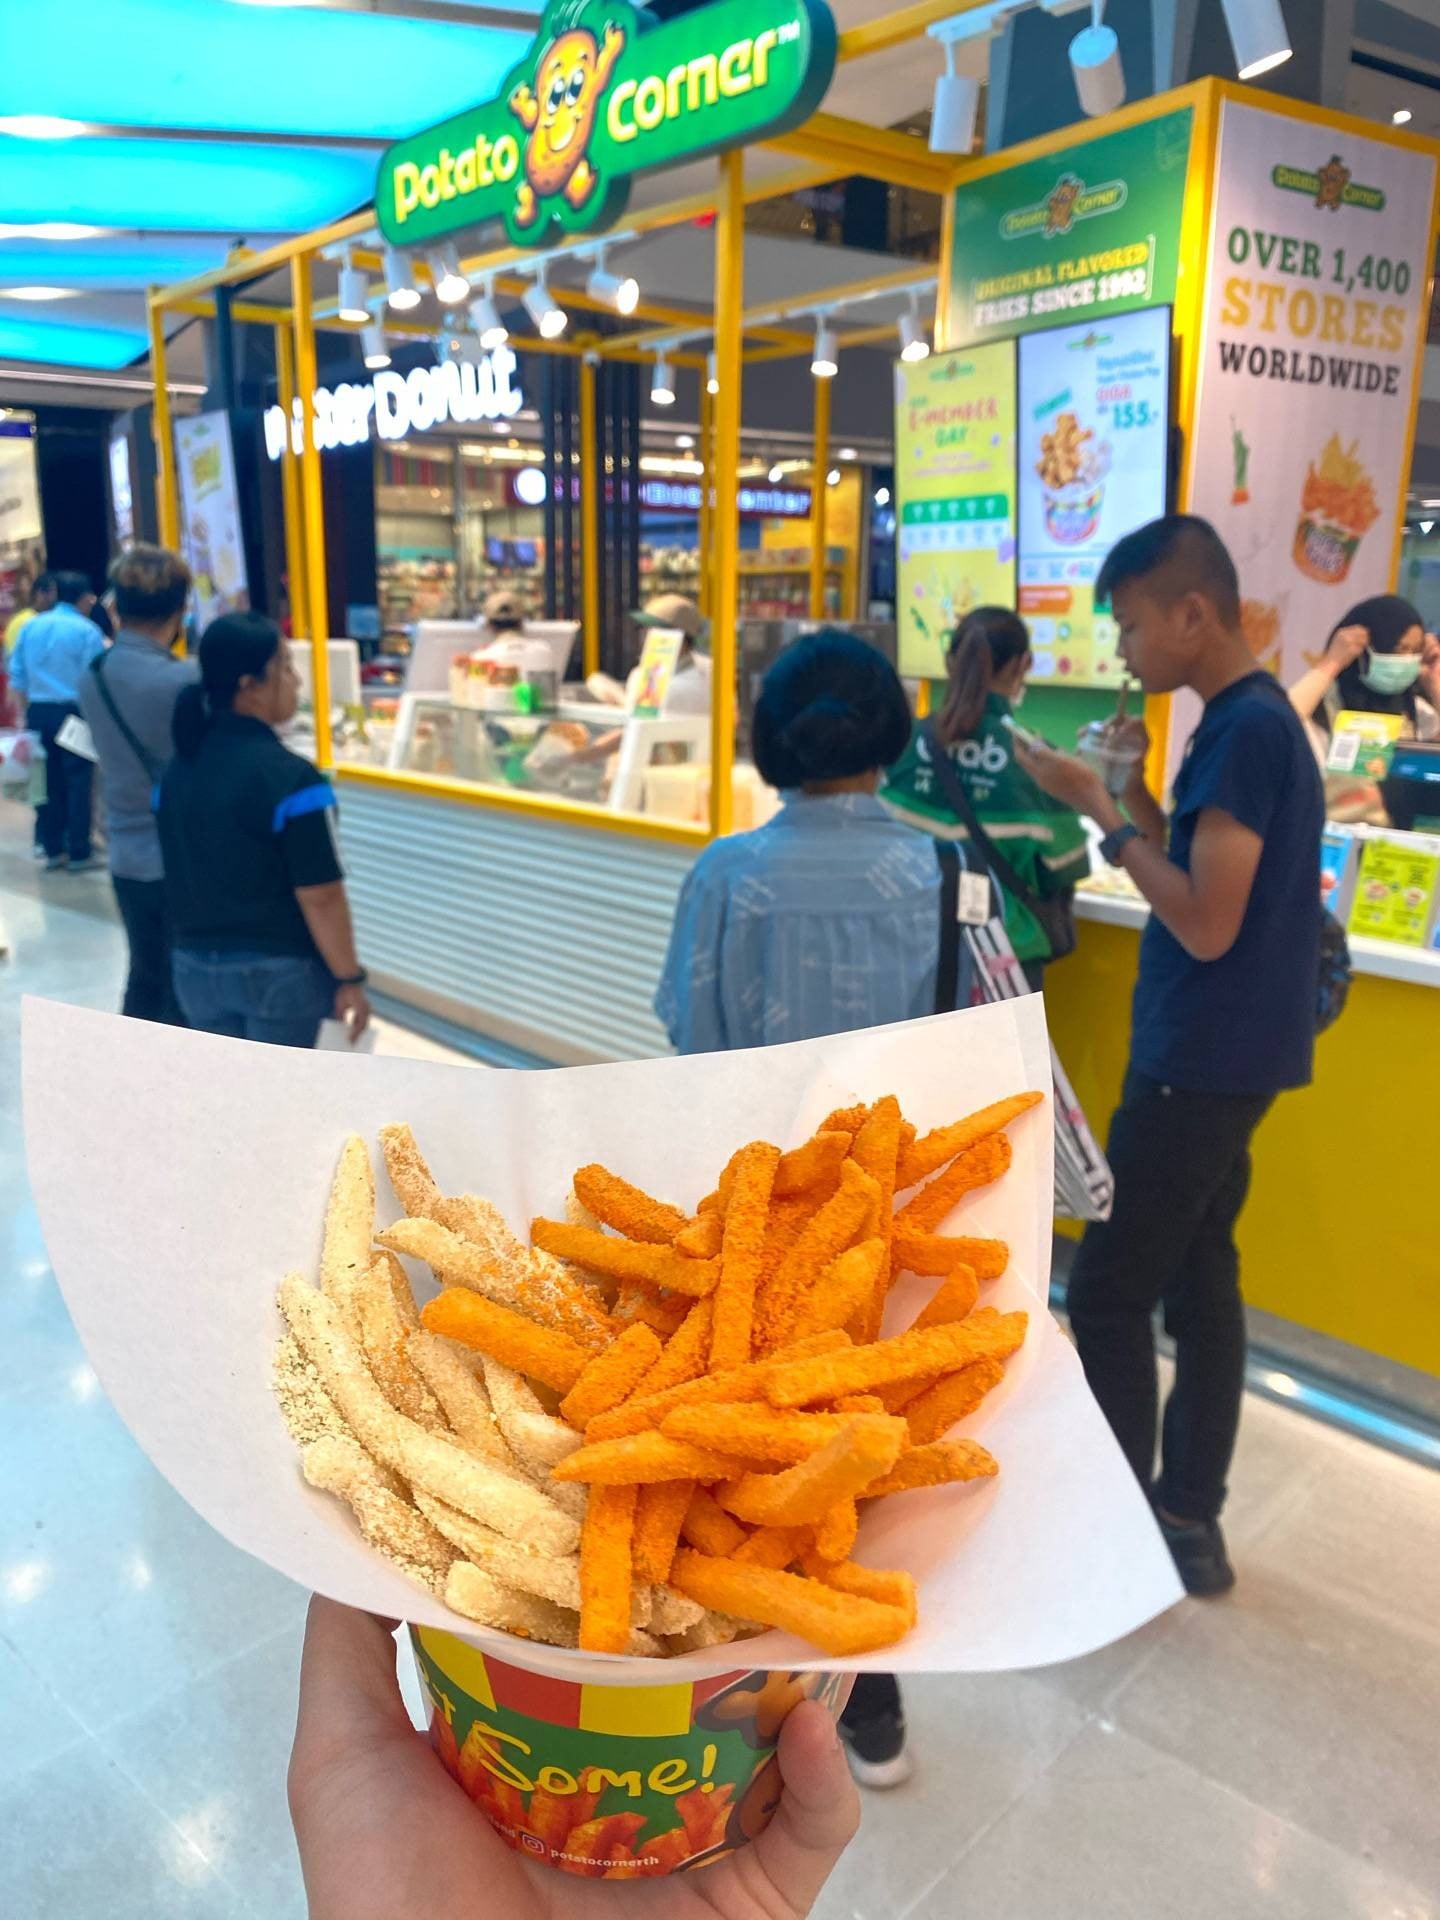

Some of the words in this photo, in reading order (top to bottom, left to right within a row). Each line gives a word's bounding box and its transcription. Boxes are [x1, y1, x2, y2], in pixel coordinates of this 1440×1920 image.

[1227, 226, 1321, 279] OVER
[1332, 248, 1412, 295] 1,400
[1031, 278, 1096, 315] SINCE
[1220, 276, 1407, 352] STORES
[1218, 340, 1400, 395] WORLDWIDE
[472, 1719, 717, 1797] Some!
[550, 1848, 660, 1867] potatocornerth
